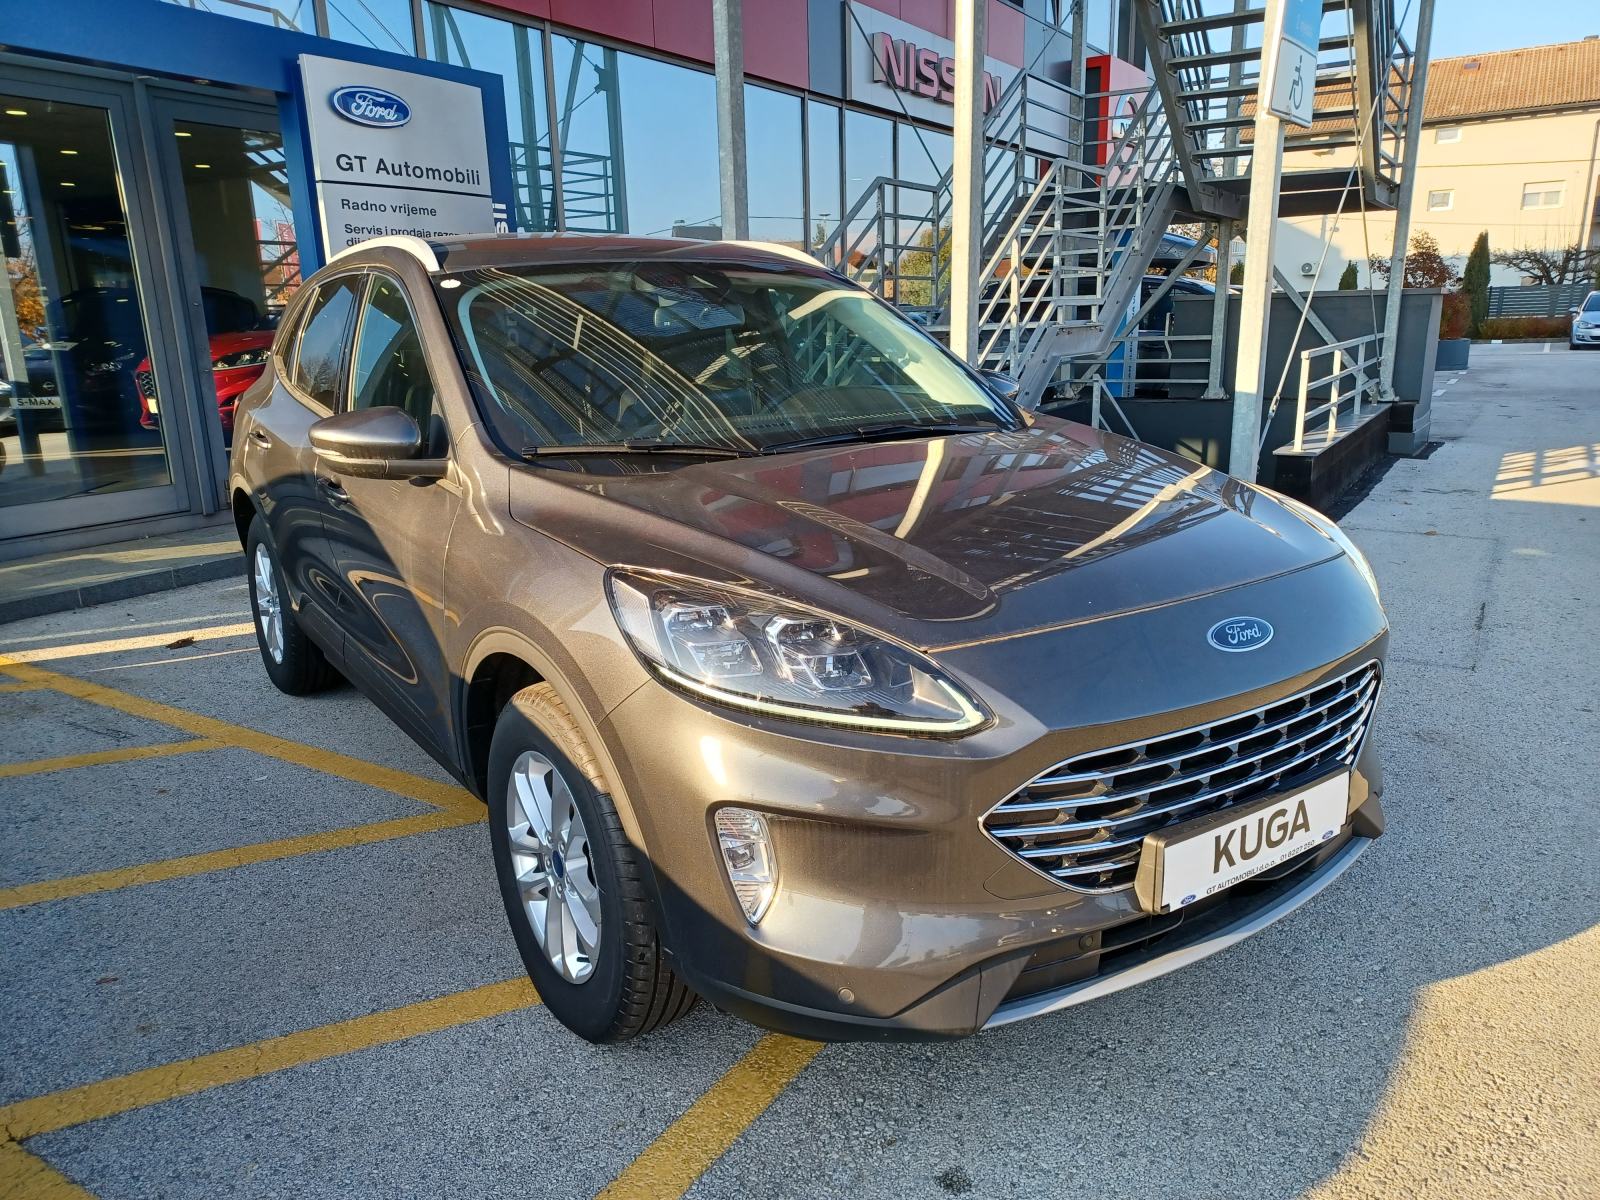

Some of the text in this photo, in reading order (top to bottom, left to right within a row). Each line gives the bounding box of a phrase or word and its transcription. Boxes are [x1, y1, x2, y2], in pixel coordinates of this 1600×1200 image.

[873, 32, 1001, 114] NISSN
[351, 92, 398, 121] Ford
[336, 154, 480, 185] GT Automobili
[341, 199, 437, 216] Radno vrijeme
[344, 224, 383, 235] Servis
[17, 398, 55, 406] S-MAX
[1226, 622, 1261, 644] Ford
[1213, 800, 1310, 873] KUGA
[1206, 886, 1218, 895] GT
[1217, 865, 1259, 890] AUTOMOBILI
